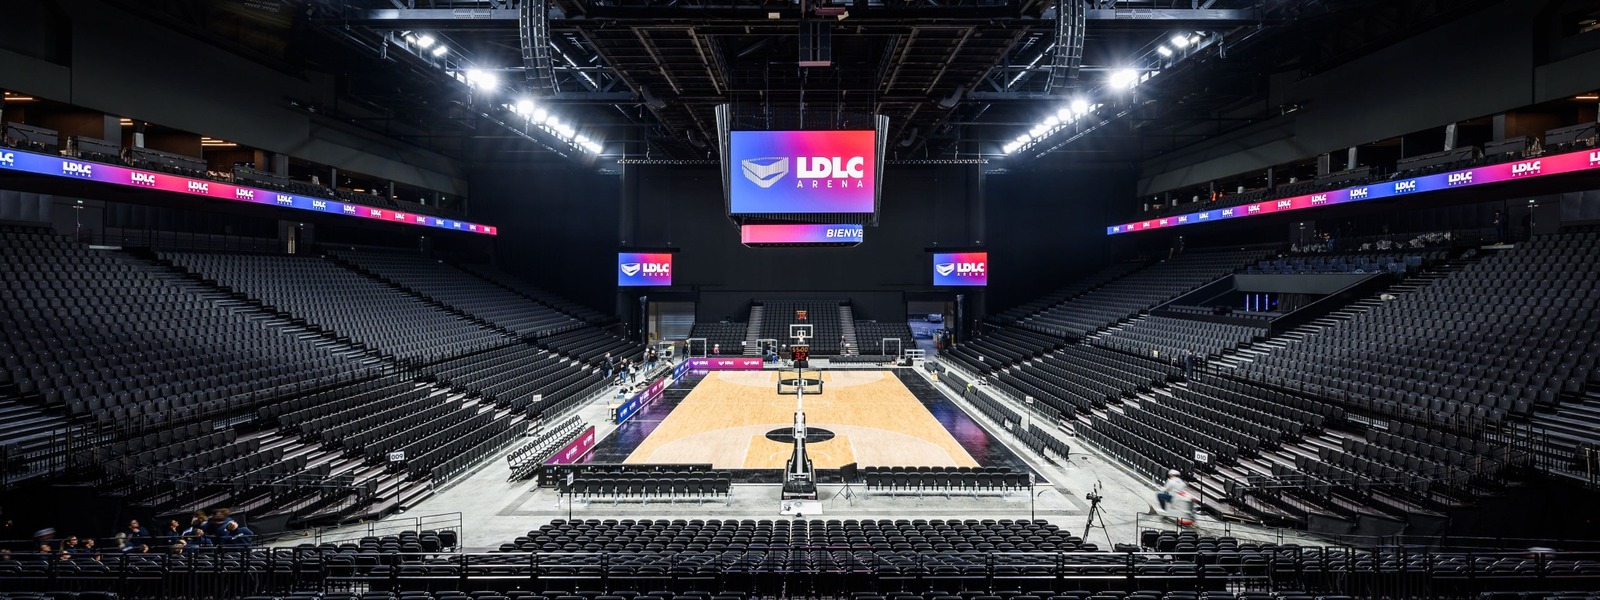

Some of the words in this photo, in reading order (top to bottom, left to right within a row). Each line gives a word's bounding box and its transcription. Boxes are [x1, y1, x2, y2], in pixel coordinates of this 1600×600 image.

[63, 161, 92, 174] LDLC
[797, 156, 864, 179] LDLC
[1512, 161, 1541, 173] LDLC
[131, 172, 155, 183] LDLC
[1448, 171, 1472, 183] LDLC
[188, 181, 208, 191] LDLC
[797, 180, 864, 188] ARENA
[1395, 180, 1416, 190] LDLC
[236, 188, 253, 197] LDLC
[1350, 187, 1367, 197] LDLC
[277, 195, 292, 203] LDLC
[1312, 194, 1326, 203] LDLC
[1277, 200, 1291, 208] LDLC
[643, 263, 670, 273] LDLC
[957, 262, 985, 273] LDLC
